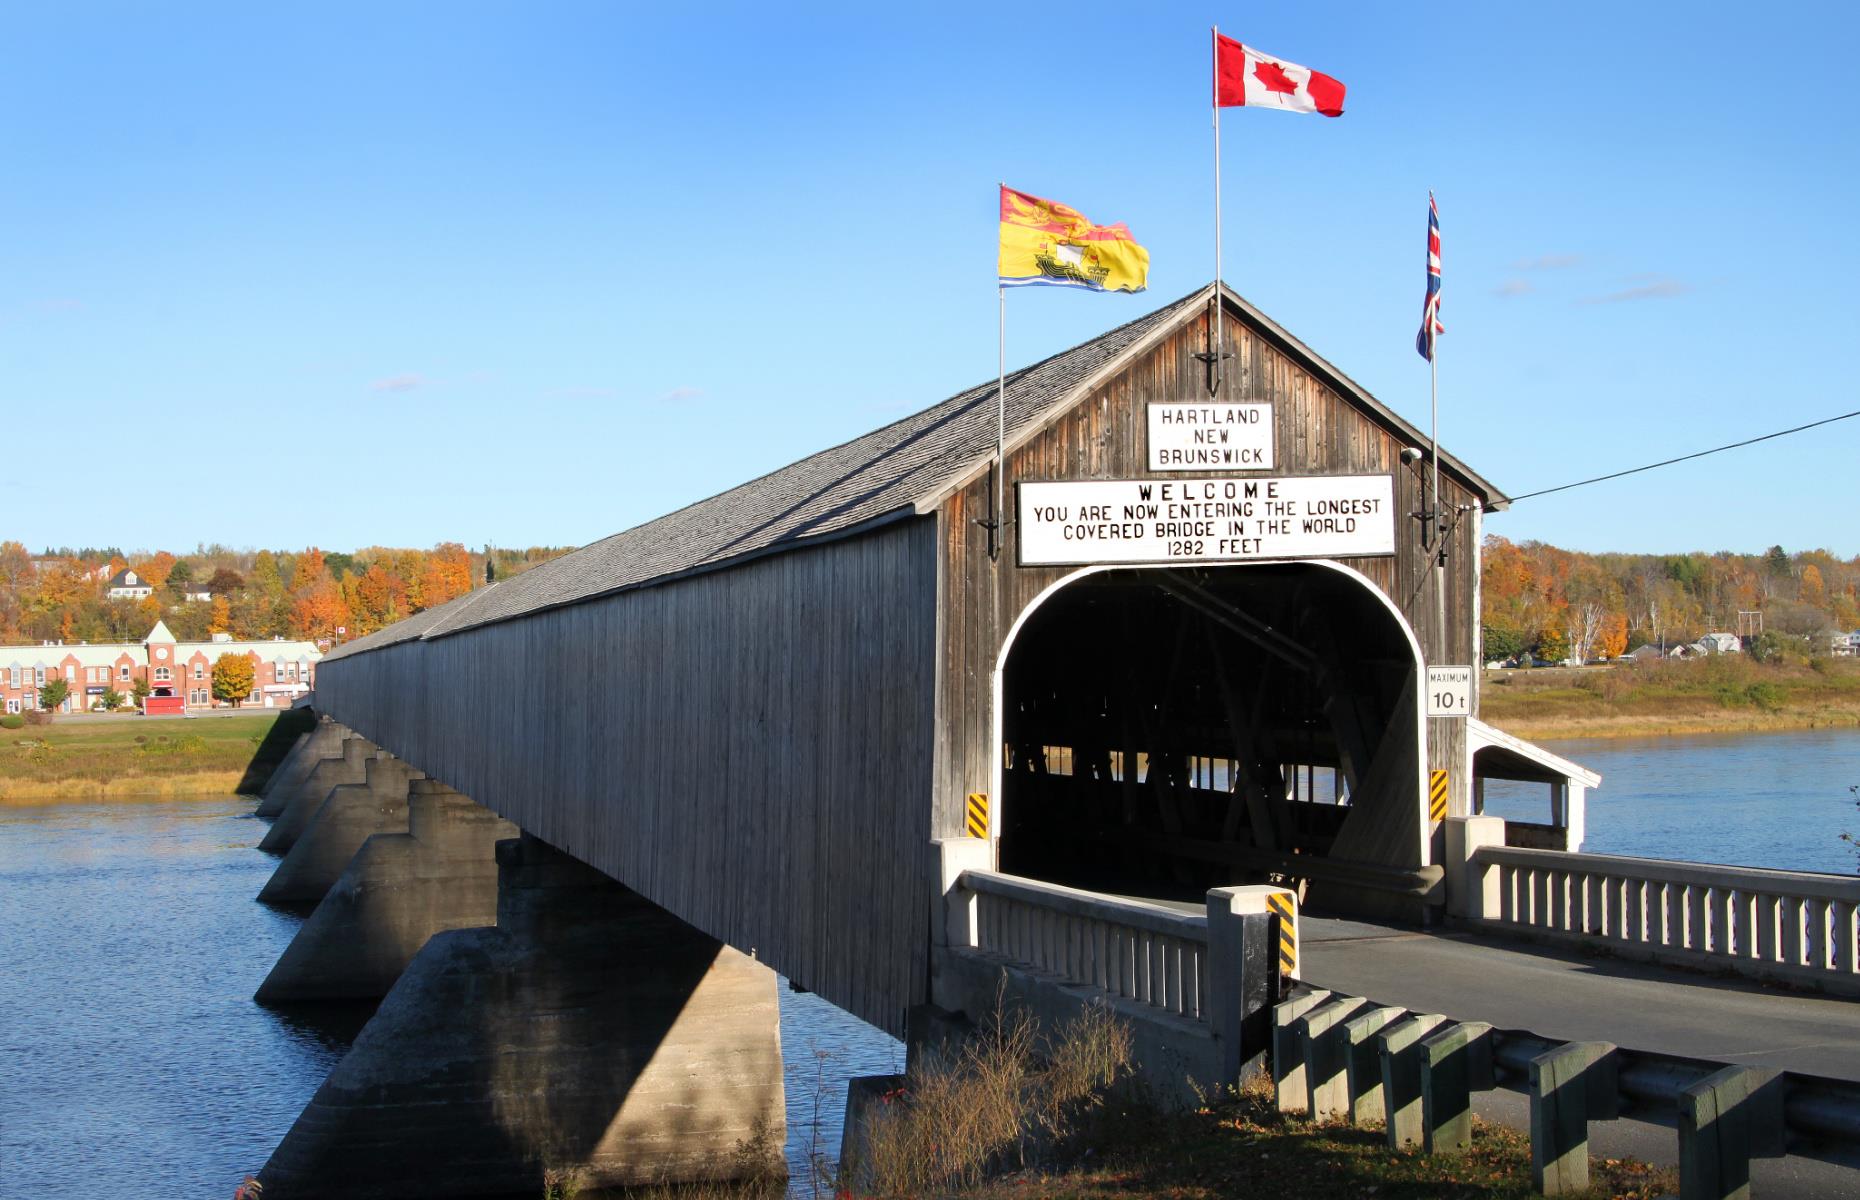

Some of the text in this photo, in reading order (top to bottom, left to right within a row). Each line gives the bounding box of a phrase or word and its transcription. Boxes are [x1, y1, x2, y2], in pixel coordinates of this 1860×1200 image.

[1162, 409, 1259, 424] HARTLAND
[1195, 429, 1228, 444] NEW
[1160, 449, 1262, 464] BRUNSWICK
[1139, 482, 1278, 500] WELCOME
[1034, 499, 1380, 522] YOU ARE NOW ENTERING THE LONGEST
[1064, 518, 1355, 540] COVERED BRIDGE IN THE WORLD
[1168, 538, 1262, 556] 1282 FEET
[1430, 673, 1468, 683] MAXIMUM
[1434, 692, 1465, 708] 10 t
